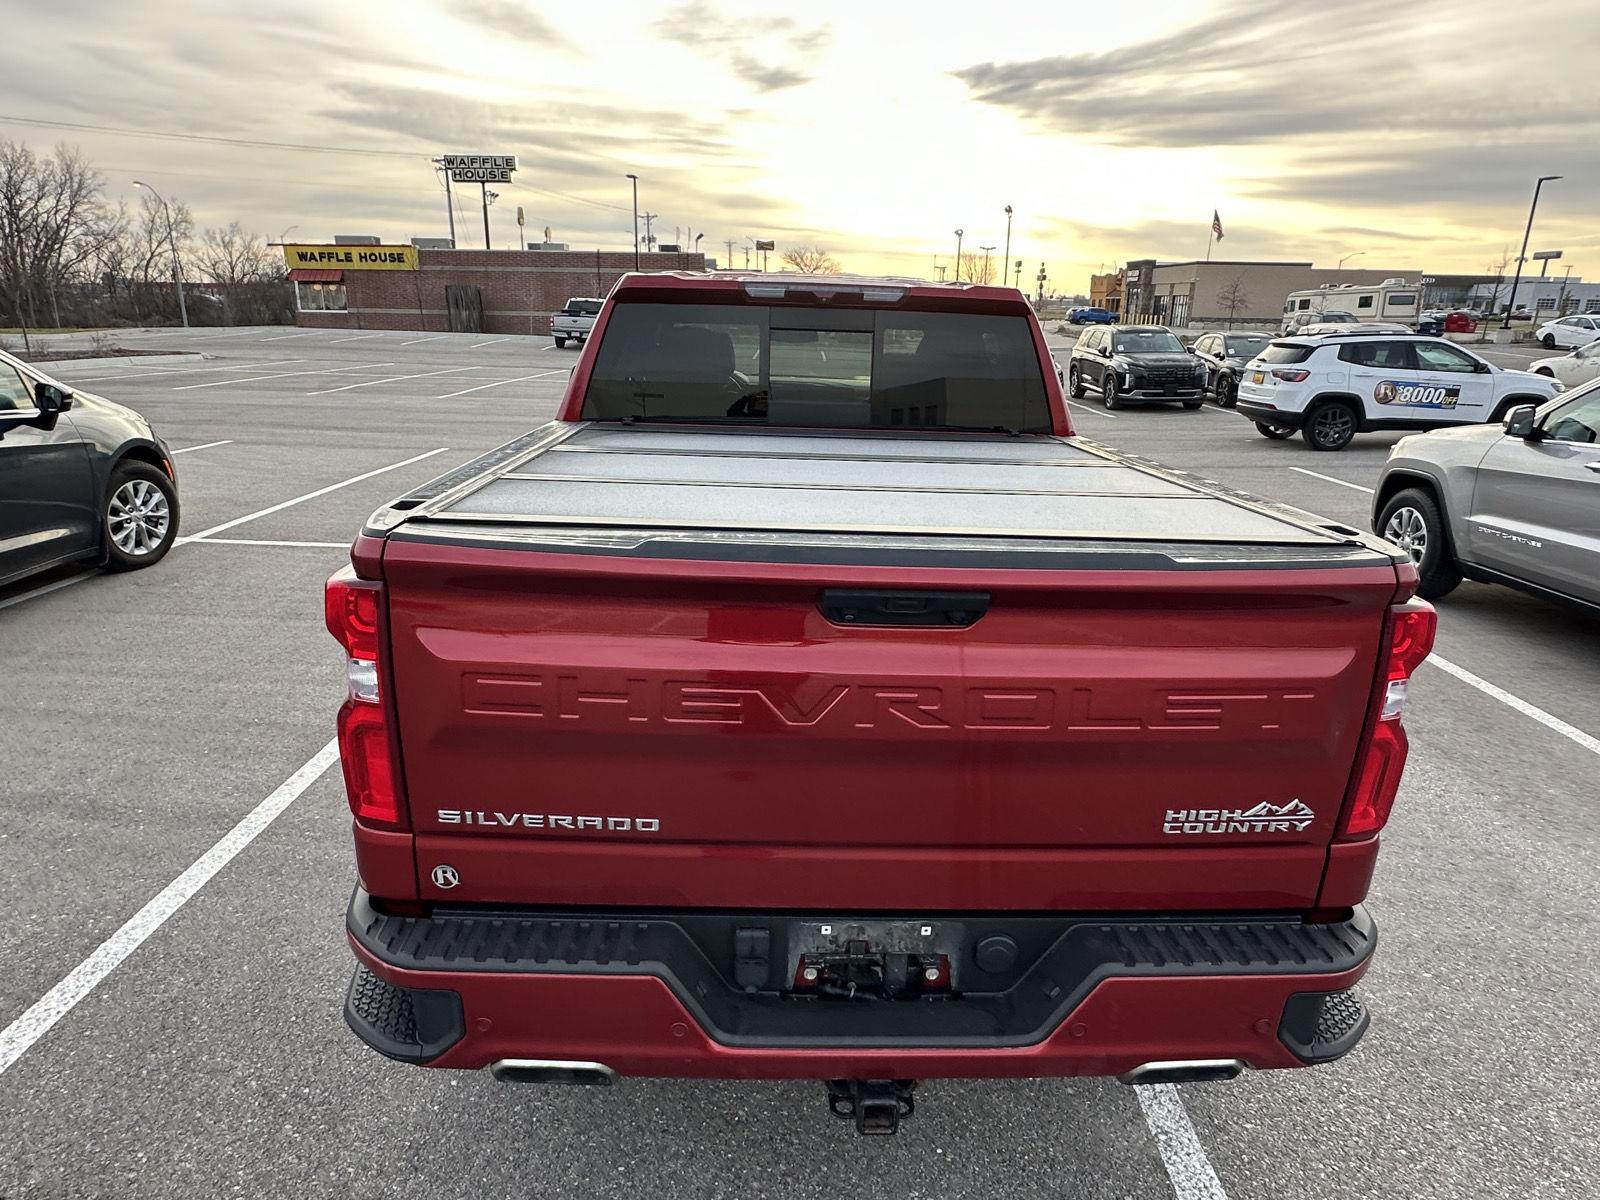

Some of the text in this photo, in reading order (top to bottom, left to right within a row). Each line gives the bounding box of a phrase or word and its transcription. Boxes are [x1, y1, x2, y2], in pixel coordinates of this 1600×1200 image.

[445, 157, 514, 167] WAFFLE
[453, 170, 508, 180] HOUSE
[296, 251, 404, 263] WAFFLE HOUSE
[1442, 396, 1457, 405] OFF
[461, 672, 1316, 730] CHEVROLET
[437, 809, 660, 832] SILVERADO
[1165, 809, 1242, 821] HIGH
[1162, 821, 1314, 834] COUNTRY
